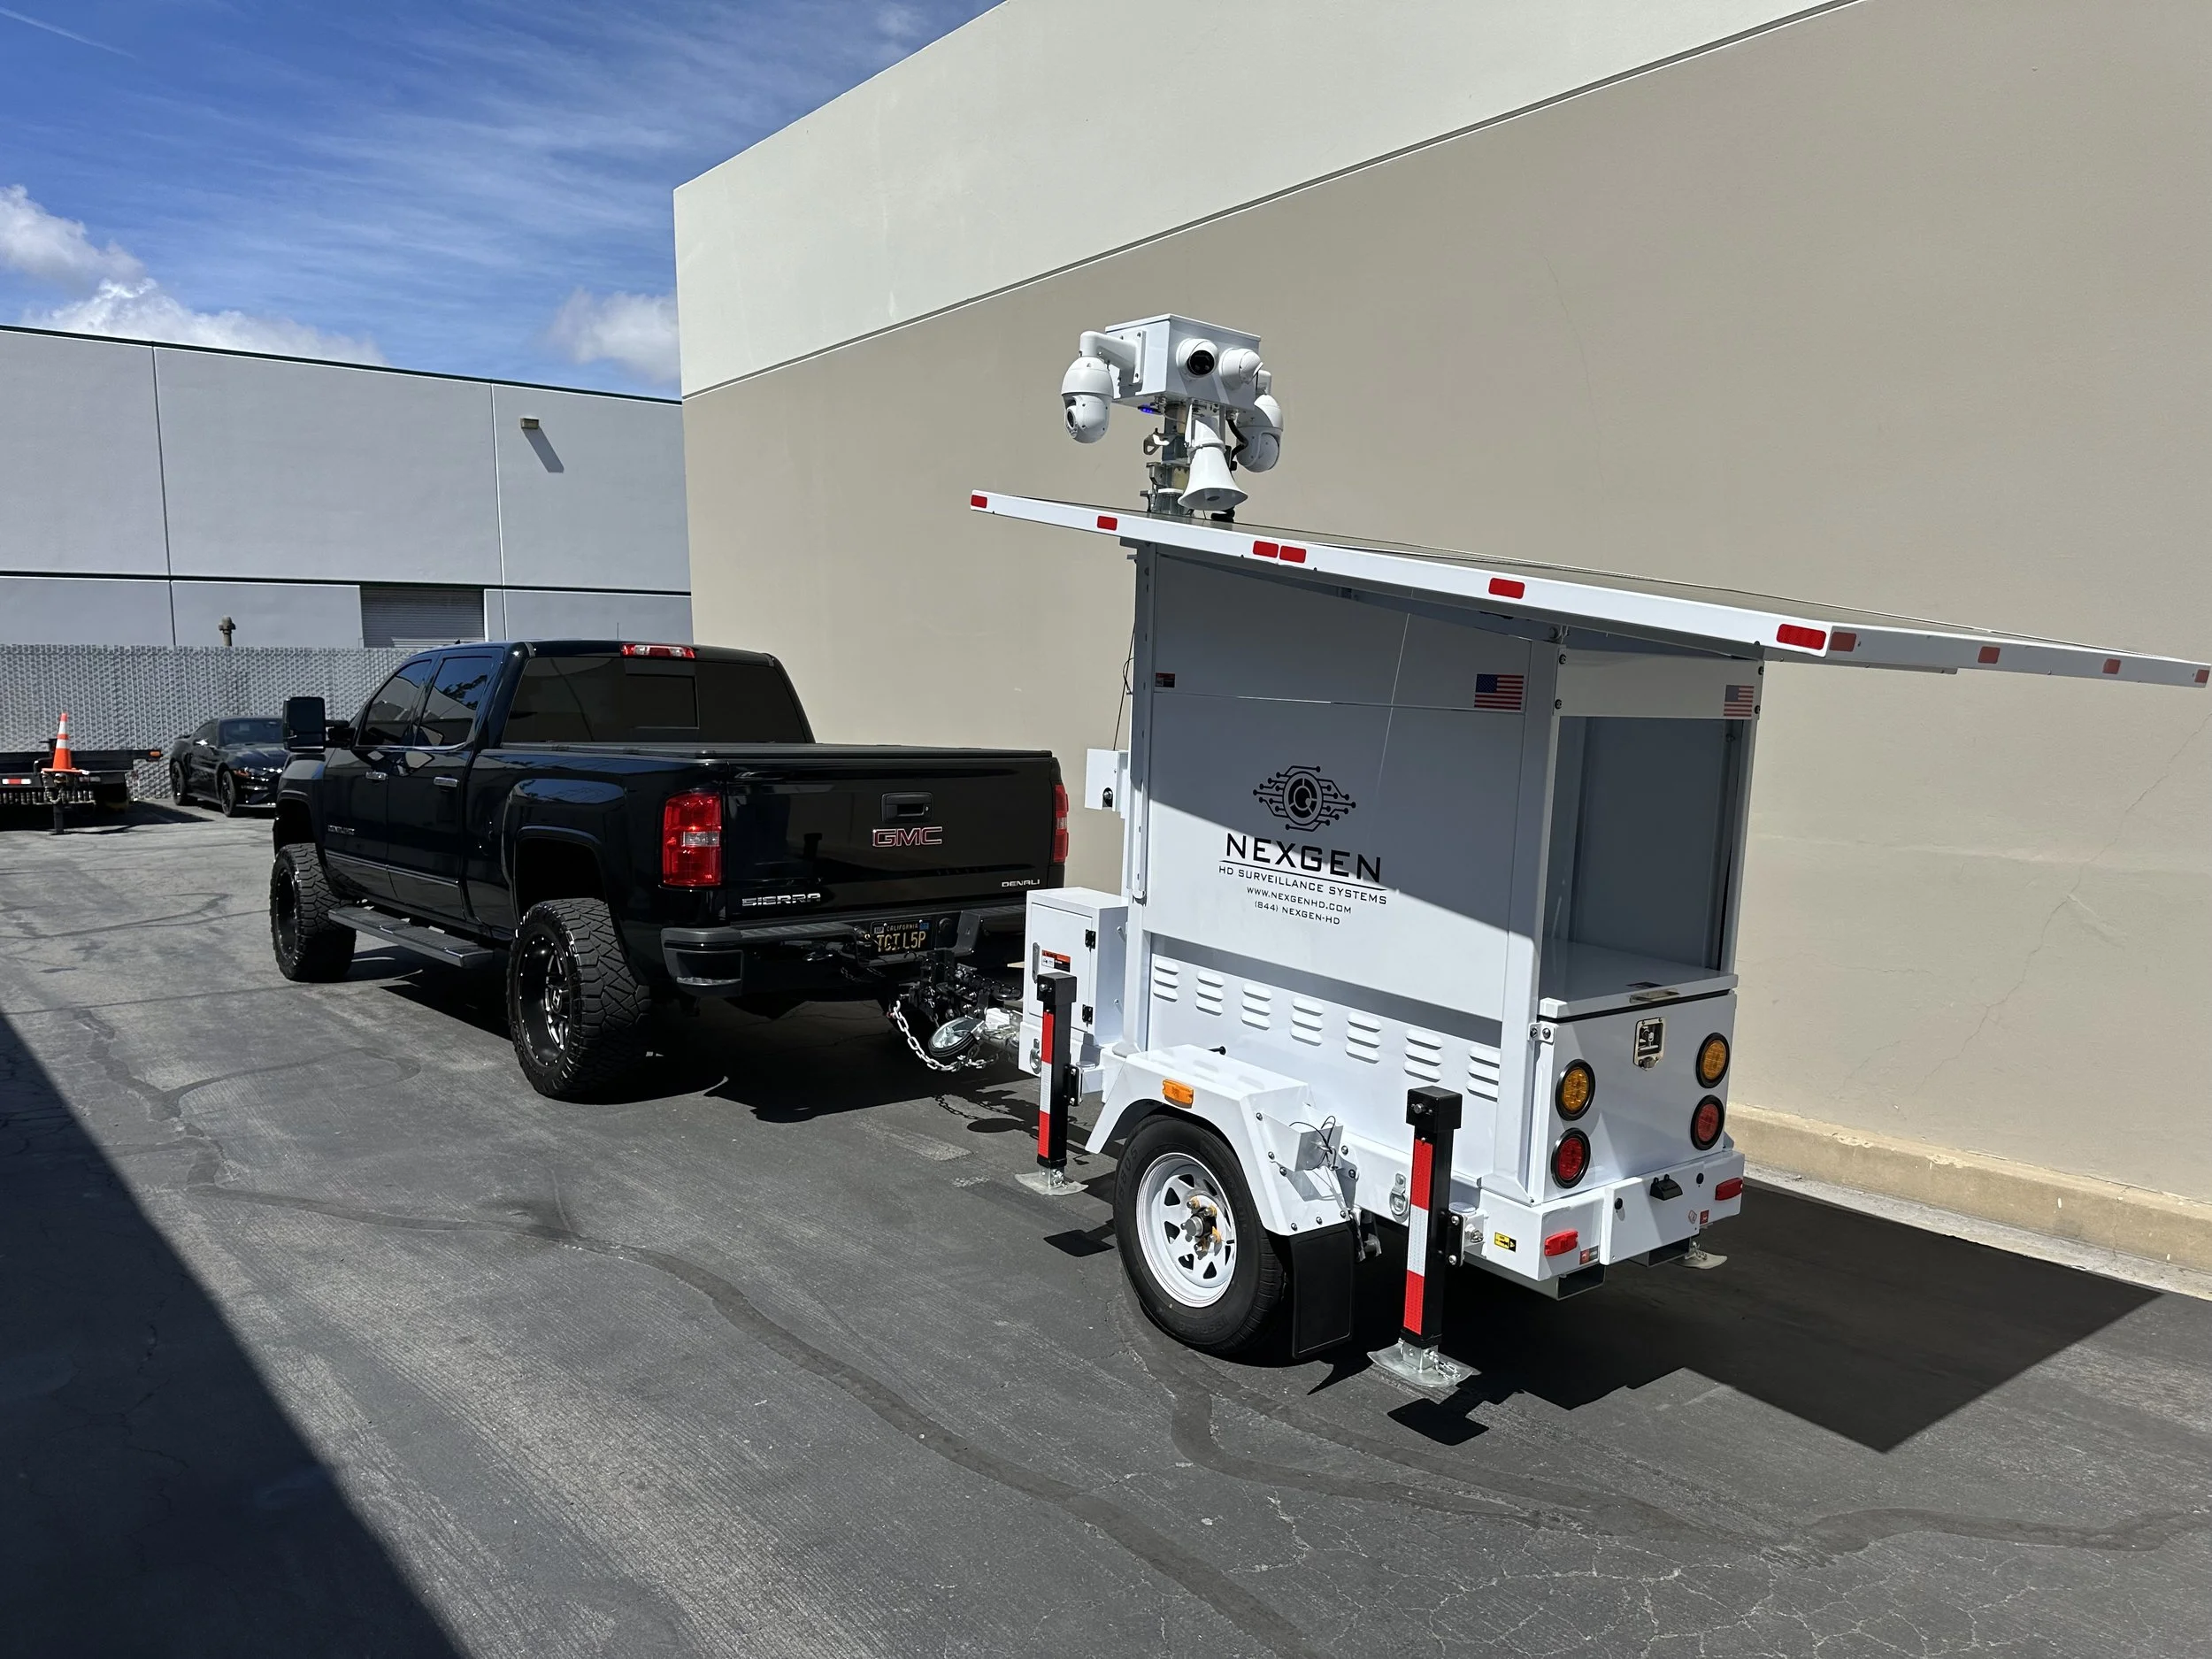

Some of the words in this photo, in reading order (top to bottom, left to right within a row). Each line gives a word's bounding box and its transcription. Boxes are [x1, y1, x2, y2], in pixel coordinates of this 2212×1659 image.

[872, 826, 942, 848] GMC
[1225, 833, 1381, 883] NEXGEN
[1001, 879, 1041, 887] DENALI
[1218, 865, 1234, 876] HD
[1238, 869, 1325, 894] SURVEILLANCE
[1329, 886, 1387, 905] SYSTEMS
[741, 893, 821, 907] SIERRA
[1246, 886, 1352, 915] WWW.NEXGENHD.COM
[1254, 901, 1279, 914] (844)
[1281, 907, 1340, 926] NEXGEN-HD
[887, 923, 918, 933] CALIFORNIA
[902, 931, 926, 949] L5P
